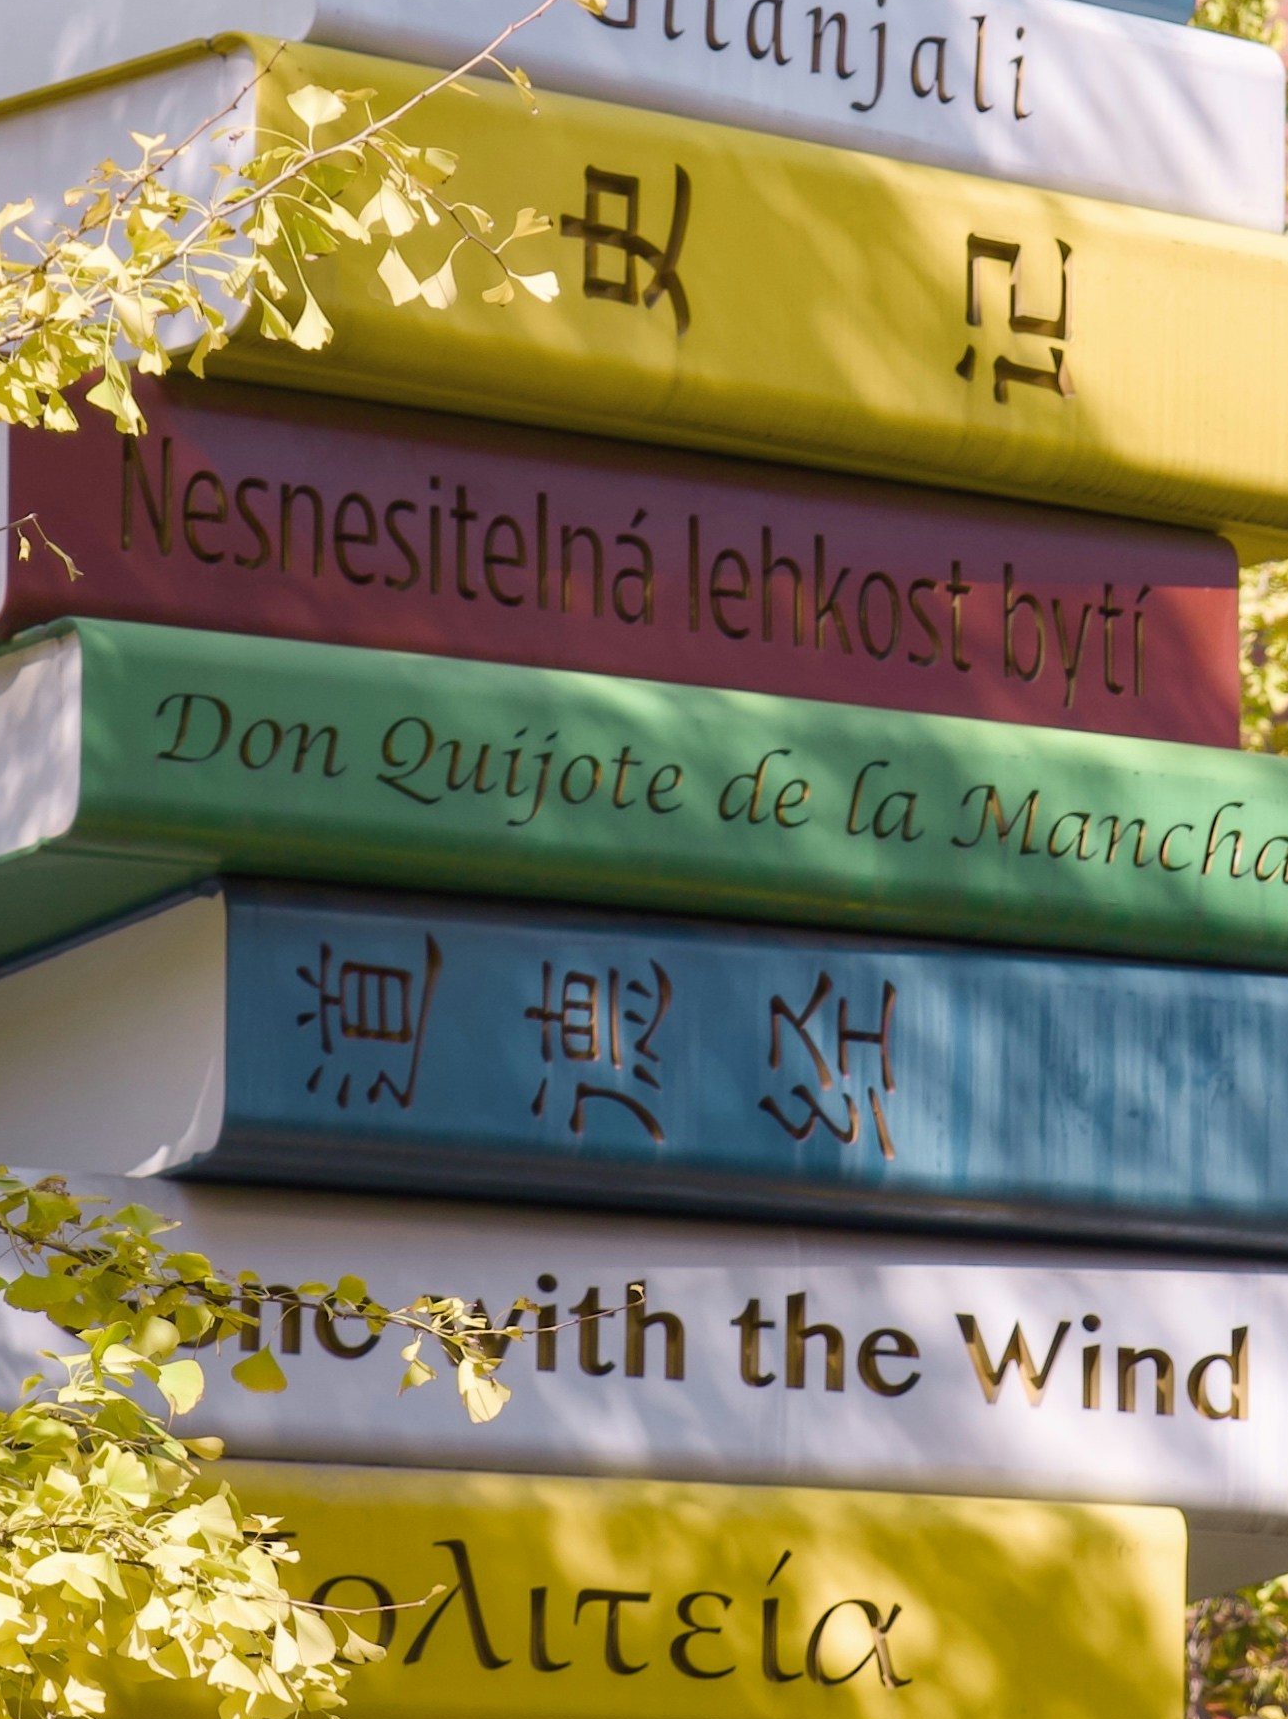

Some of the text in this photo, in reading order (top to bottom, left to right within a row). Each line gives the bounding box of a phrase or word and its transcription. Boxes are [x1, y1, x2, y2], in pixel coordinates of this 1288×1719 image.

[559, 162, 1076, 405] 史记
[118, 433, 1150, 709] Nesnesitelná lehkost bytí
[153, 691, 348, 780] Don
[376, 714, 684, 828] Quijote
[716, 747, 812, 829] de
[844, 760, 925, 844] la
[295, 931, 898, 1161] 道德经
[729, 1291, 922, 1398] the
[954, 1311, 1250, 1422] Wind
[241, 1530, 913, 1691] ολιτεία
